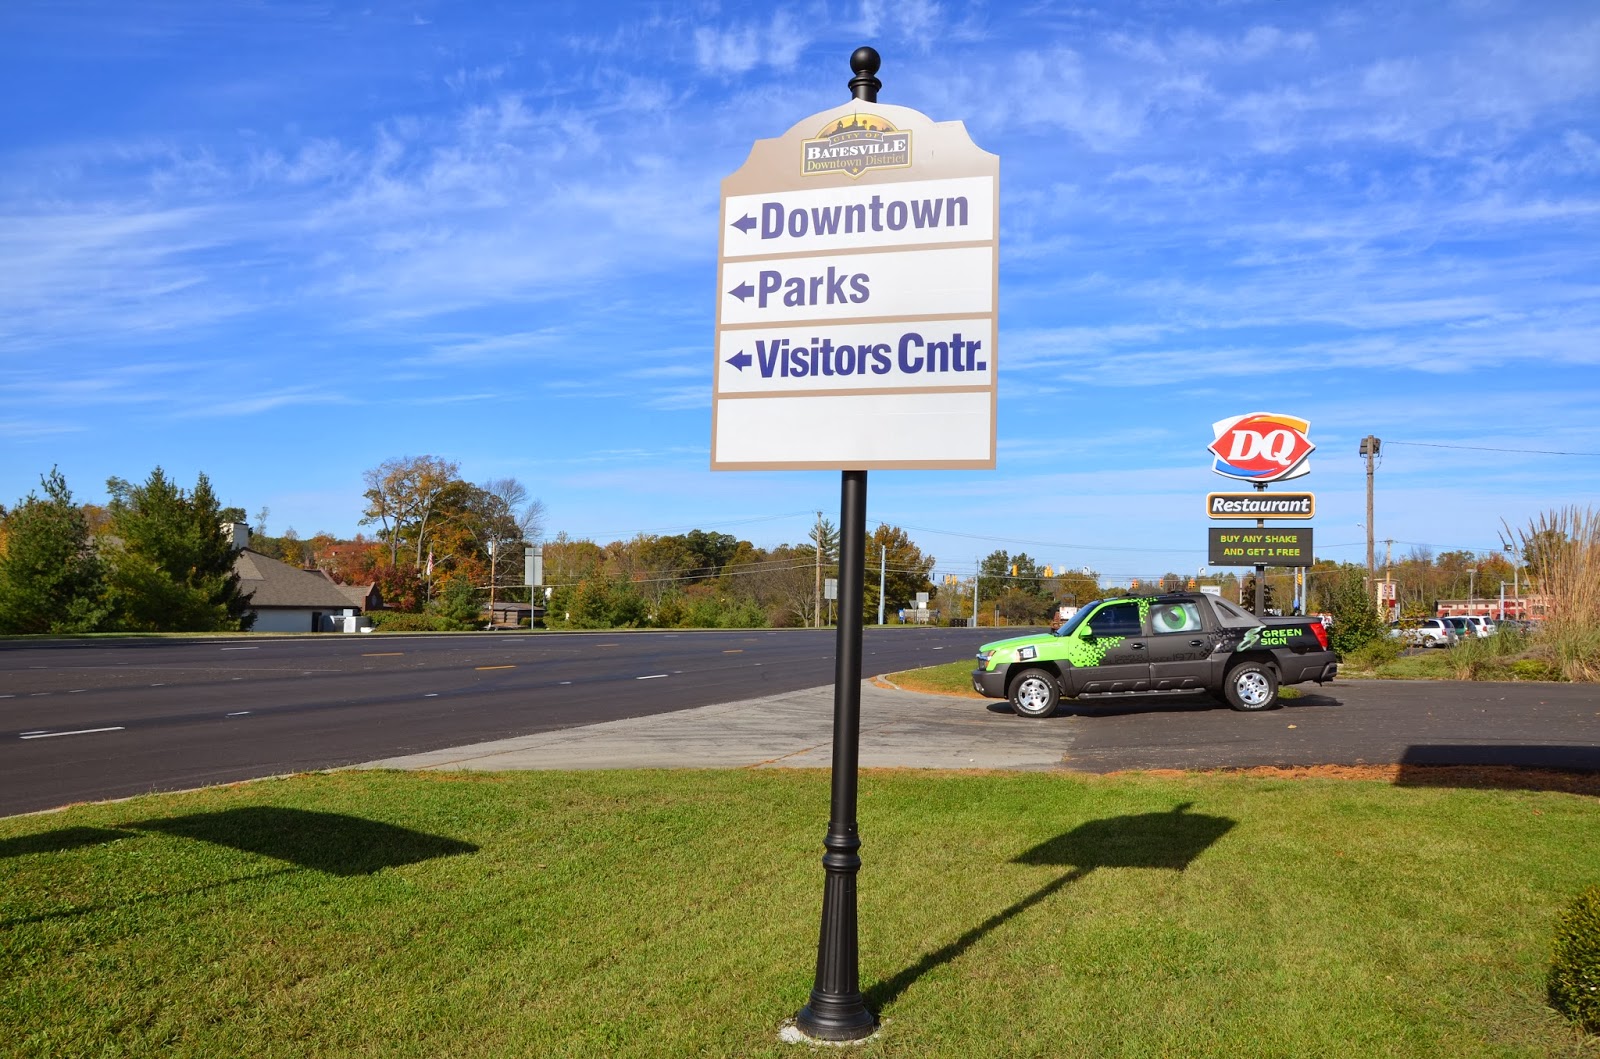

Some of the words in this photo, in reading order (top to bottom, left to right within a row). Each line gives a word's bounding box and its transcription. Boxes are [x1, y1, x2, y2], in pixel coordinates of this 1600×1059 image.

[833, 132, 860, 143] CITY
[807, 139, 906, 160] BATESVILLE
[807, 158, 862, 171] Downtown
[866, 153, 905, 166] District
[761, 195, 969, 240] Downtown
[758, 266, 870, 308] Parks
[755, 337, 892, 378] Visitors
[898, 332, 987, 374] Cntr.
[1227, 429, 1296, 466] DQ
[1212, 497, 1311, 512] Restaurant
[1220, 535, 1240, 543] BUY
[1242, 535, 1263, 543] ANY
[1265, 535, 1298, 543] SHAKE
[1223, 548, 1244, 556] AND
[1246, 548, 1265, 556] GET
[1267, 548, 1275, 556] 1
[1276, 548, 1300, 556] FREE
[1262, 628, 1303, 638] GREEN
[1260, 637, 1288, 646] SIGN
